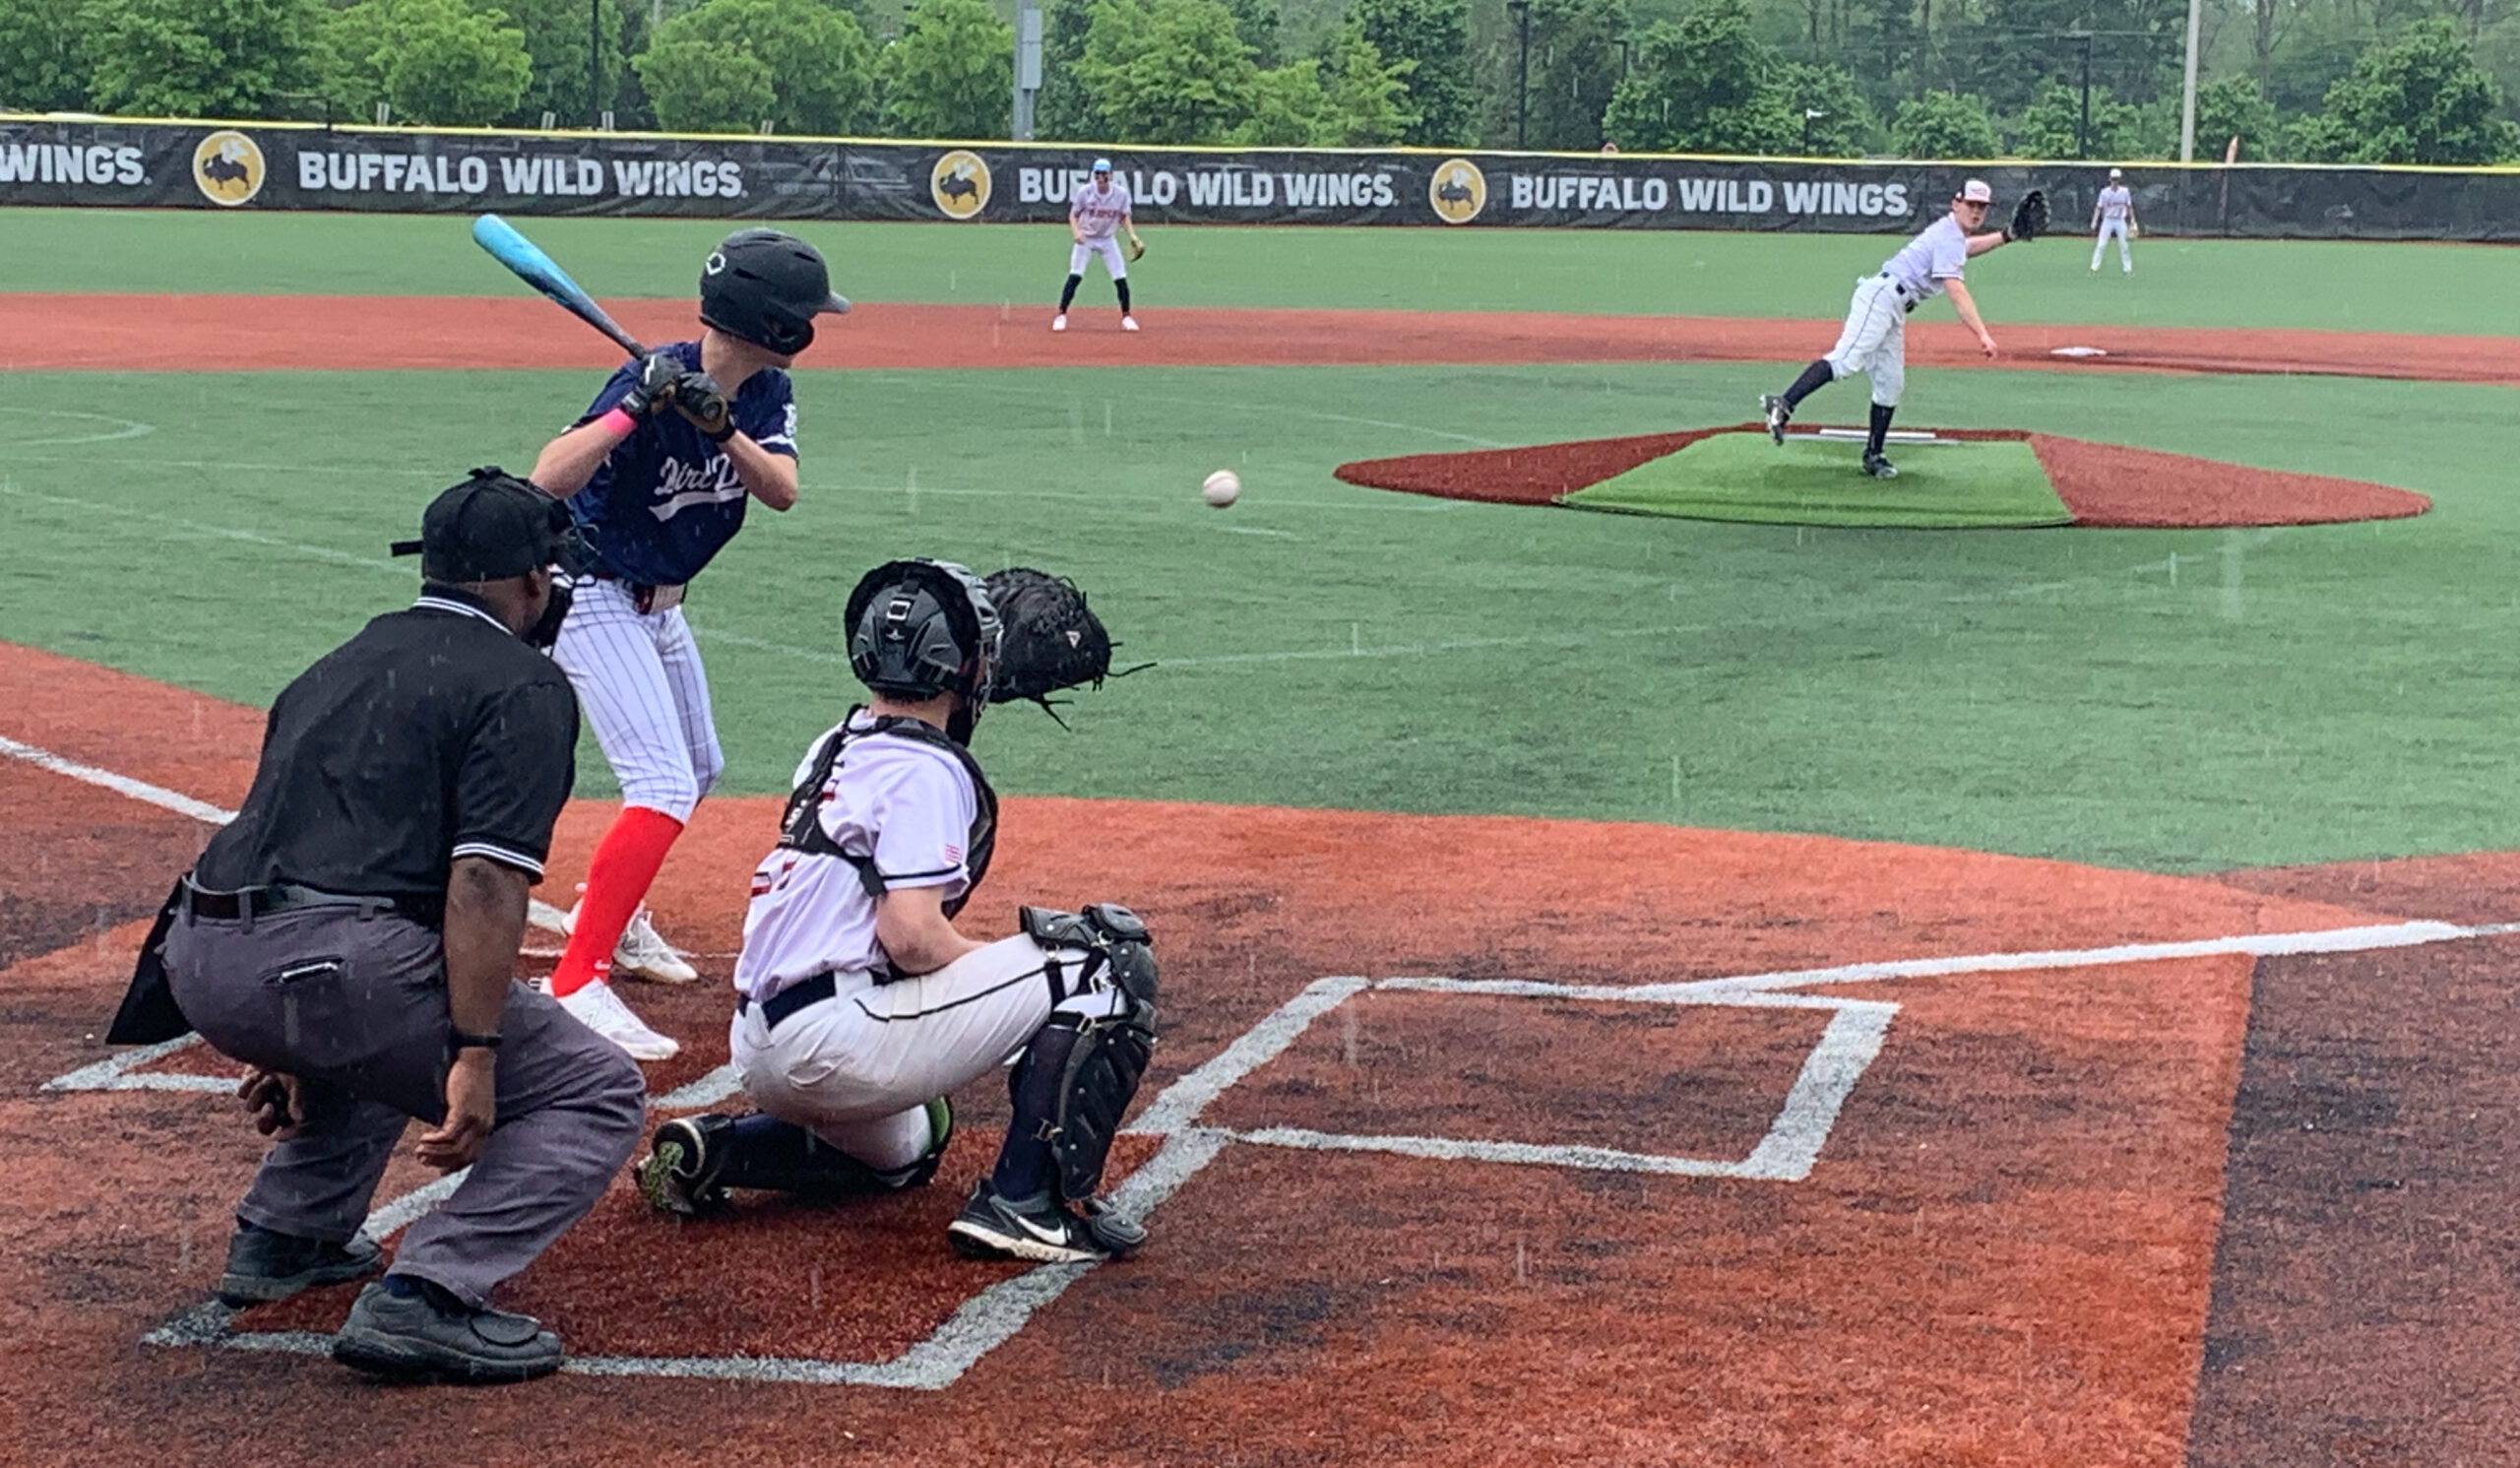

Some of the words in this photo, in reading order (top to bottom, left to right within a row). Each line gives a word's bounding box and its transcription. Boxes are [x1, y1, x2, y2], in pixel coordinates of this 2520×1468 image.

[299, 152, 488, 194] BUFFALO
[500, 157, 603, 197] WILD
[1019, 168, 1177, 206] BUFALO
[1187, 172, 1275, 208] WILD
[1511, 175, 1669, 211] BUFFALO
[1679, 178, 1772, 214] WILD
